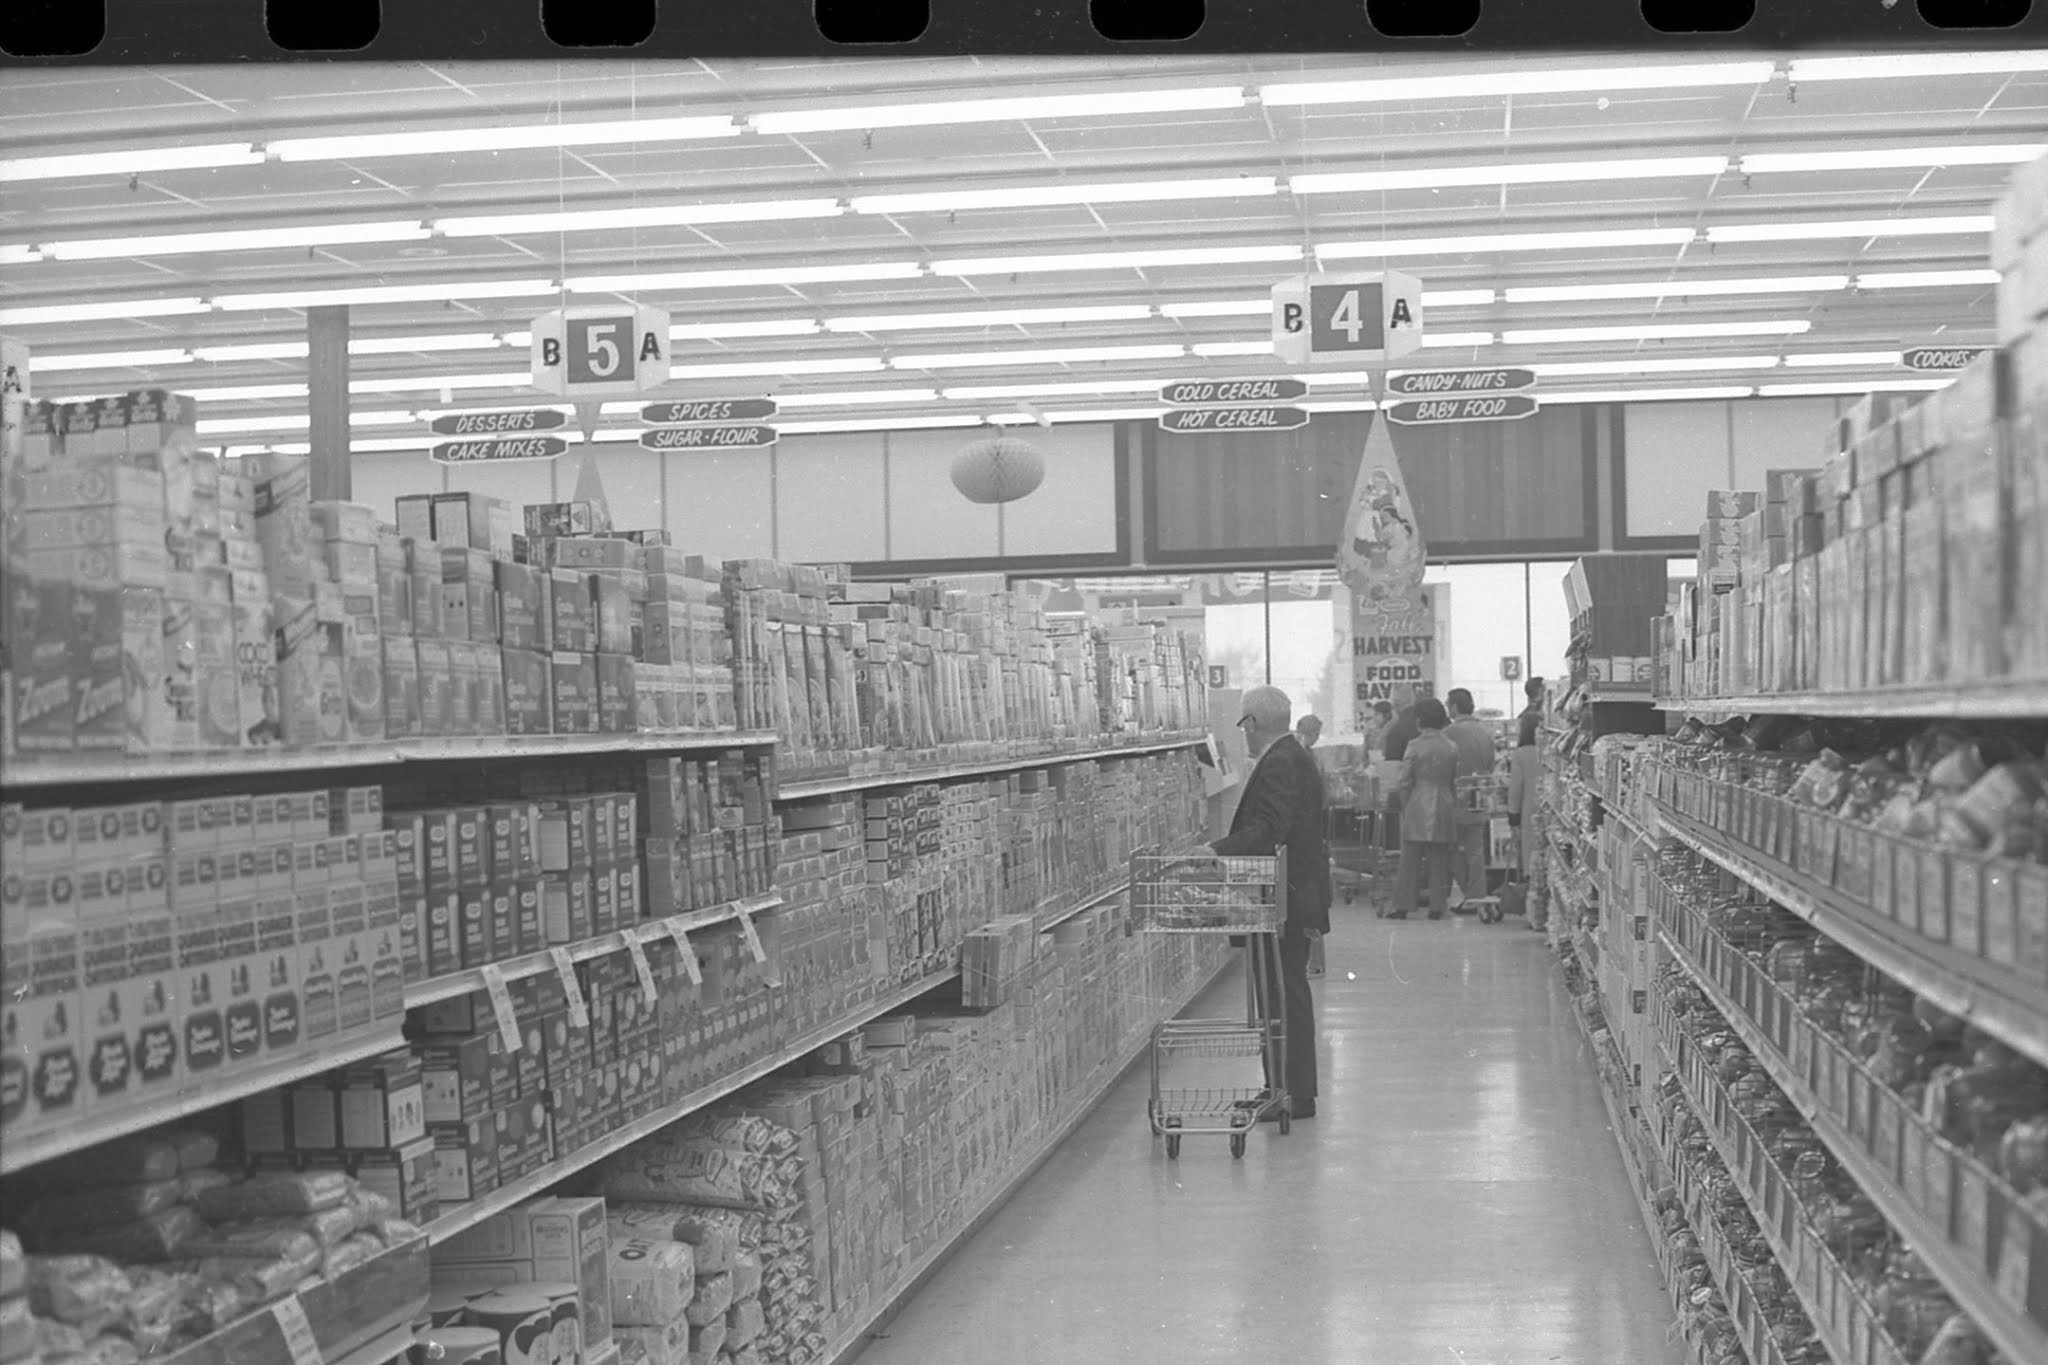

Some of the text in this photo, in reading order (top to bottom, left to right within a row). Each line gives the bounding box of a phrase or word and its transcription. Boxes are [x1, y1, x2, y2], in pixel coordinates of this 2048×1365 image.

[1283, 302, 1304, 333] B
[1330, 289, 1363, 343] 4
[1390, 298, 1412, 329] A
[542, 338, 561, 367] B
[586, 324, 620, 377] 5
[639, 332, 662, 361] A
[1912, 351, 1970, 368] COOKIES
[4, 366, 22, 393] A
[1173, 382, 1280, 401] COLD CEREAL
[668, 402, 732, 421] SPICES
[1177, 409, 1278, 428] HOT CEREAL
[1416, 398, 1506, 420] BABY FOOD
[456, 413, 536, 433] DESSERTS
[654, 428, 759, 447] SUGAR FLOUR
[447, 438, 547, 460] CAKE MIXES
[1353, 635, 1434, 656] HARVEST
[1211, 671, 1222, 685] 3
[1366, 664, 1422, 681] FOOD
[1505, 661, 1517, 676] 2
[1356, 681, 1434, 701] SAVGS
